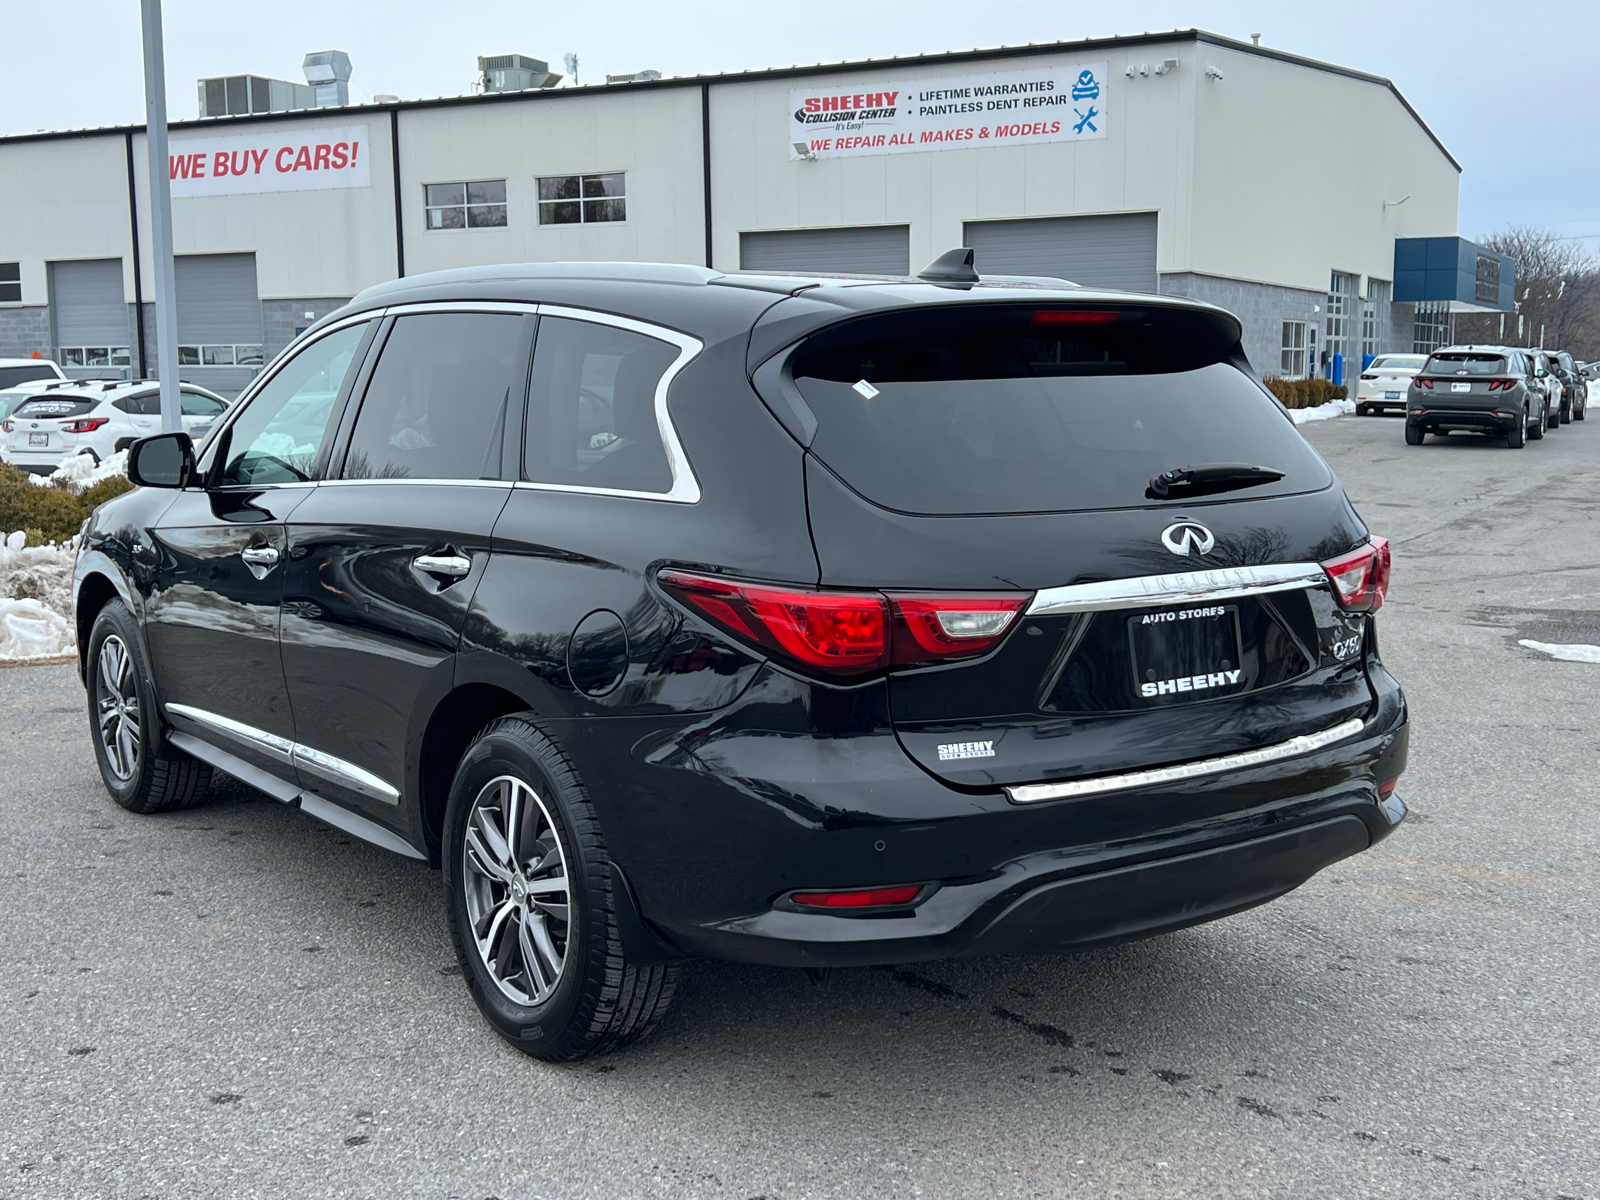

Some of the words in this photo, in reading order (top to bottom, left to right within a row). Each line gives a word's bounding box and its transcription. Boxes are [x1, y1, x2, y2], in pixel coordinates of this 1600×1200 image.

[805, 91, 899, 113] SHEEHY
[919, 87, 971, 102] LIFETIME
[974, 80, 1055, 97] WARRANTIES
[806, 110, 857, 124] COLLISION
[858, 108, 897, 120] CENTER
[919, 101, 983, 116] PAINTLESS
[987, 98, 1020, 111] DENT
[1023, 94, 1067, 108] REPAIR
[810, 139, 832, 151] WE
[835, 135, 886, 149] REPAIR
[888, 133, 915, 146] ALL
[920, 127, 974, 143] MAKES
[978, 126, 990, 139] &
[995, 121, 1061, 138] MODELS
[835, 122, 845, 131] It's
[846, 121, 864, 131] Easy!
[169, 153, 207, 180] WE
[213, 148, 269, 177] BUY
[275, 142, 359, 173] CARS!
[1140, 567, 1258, 593] INFINITI
[1142, 611, 1176, 625] AUTO
[1179, 606, 1225, 620] STORES
[1141, 669, 1241, 697] SHEEHY
[937, 740, 993, 754] SHEEHY
